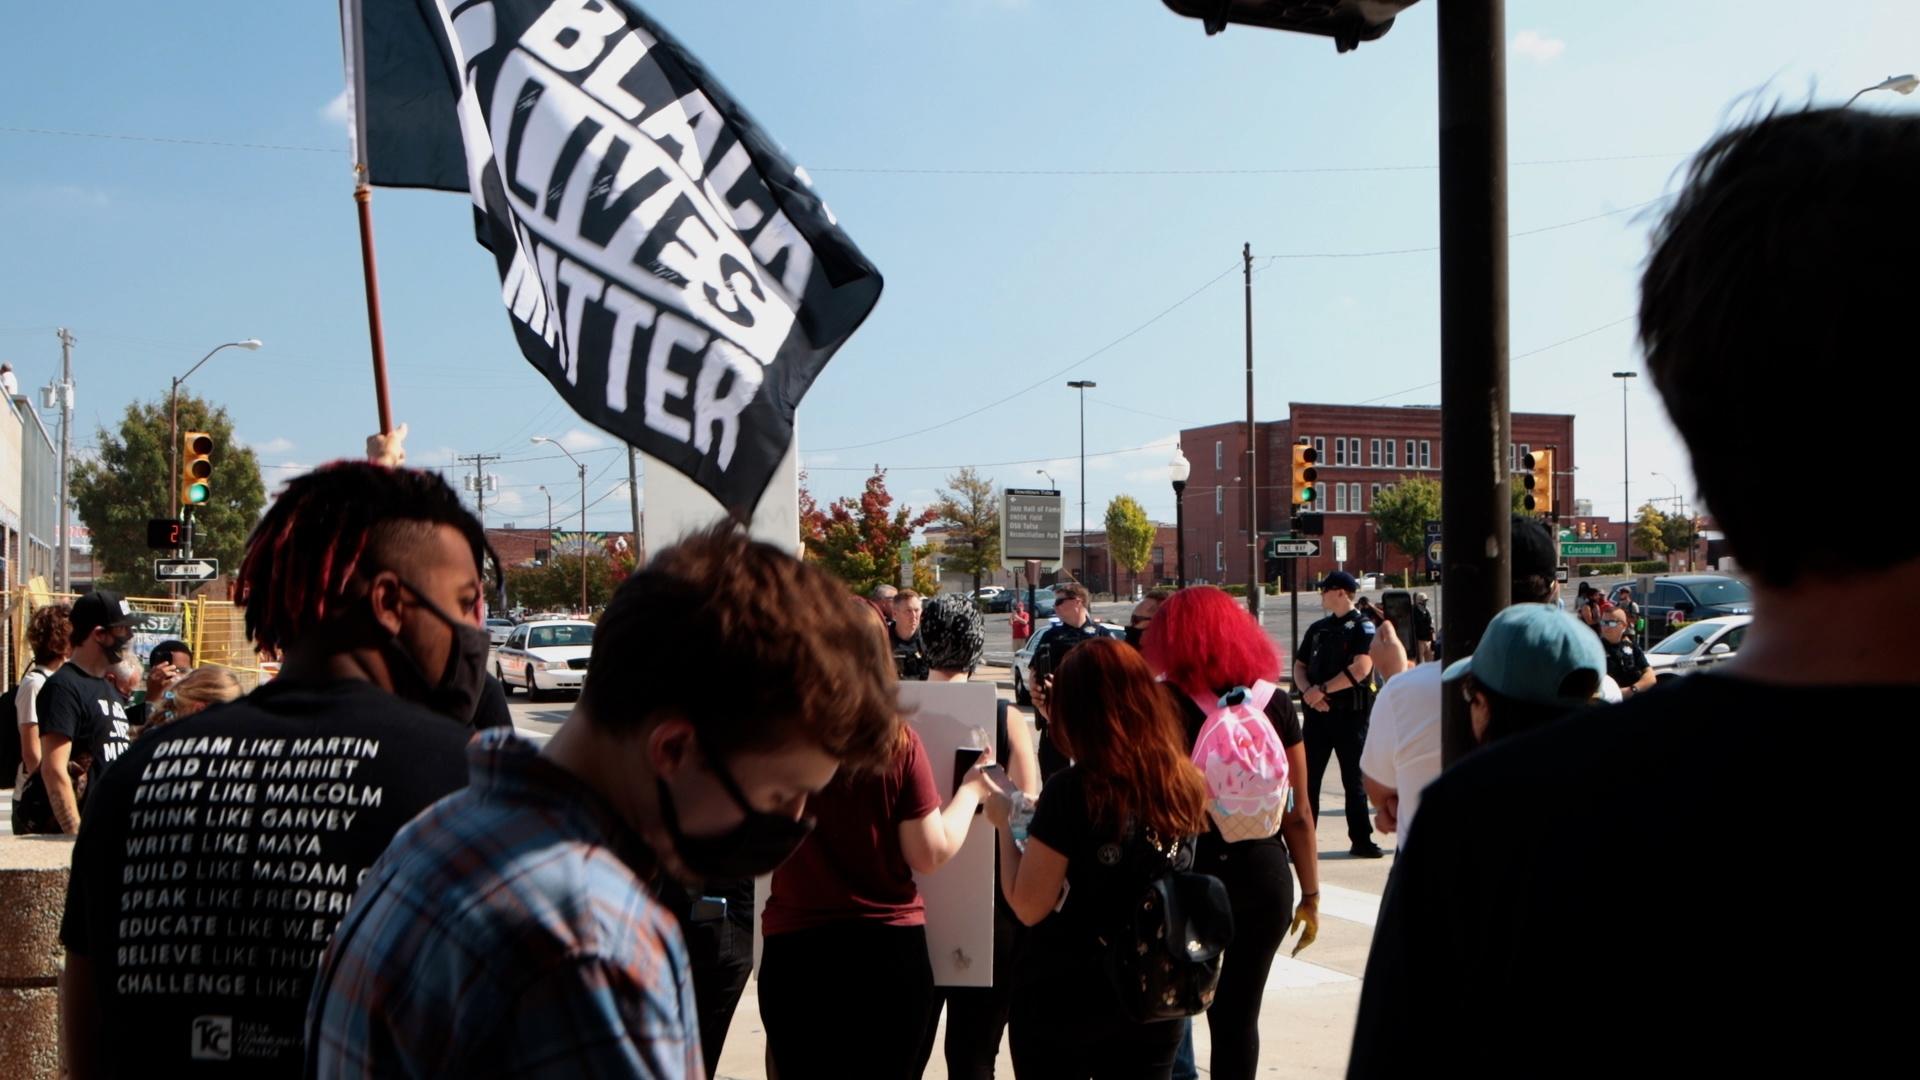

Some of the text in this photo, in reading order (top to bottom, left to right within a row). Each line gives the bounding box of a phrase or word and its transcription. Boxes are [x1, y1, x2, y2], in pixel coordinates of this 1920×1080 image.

[518, 0, 814, 313] BLACK
[505, 78, 767, 328] LIVES
[503, 222, 764, 473] MATTER
[1023, 505, 1036, 513] Hall
[1037, 505, 1044, 513] of
[1045, 505, 1060, 513] Fame
[170, 524, 178, 543] 2
[1567, 545, 1602, 554] Cincinnati
[163, 566, 199, 574] ONE WAY
[152, 736, 380, 760] DREAM LIKE MARTIN
[141, 757, 360, 781] LEAD LIKE HARRIET
[133, 781, 383, 808] FIGHT LIKE MALCOLM
[130, 806, 357, 831] THINK LIKE GARVEY
[125, 832, 322, 857] WRITE LIKE MAYA
[123, 860, 188, 884] BUILD
[196, 860, 244, 881] LIKE
[252, 860, 347, 886] MADAM
[121, 888, 188, 912] SPEAK
[196, 888, 244, 909] LIKE
[119, 915, 342, 942] EDUCATE LIKE W.E.
[117, 945, 202, 967] BELIEVE
[212, 946, 258, 968] LIKE
[117, 974, 301, 997] CHALLENGE LIKE
